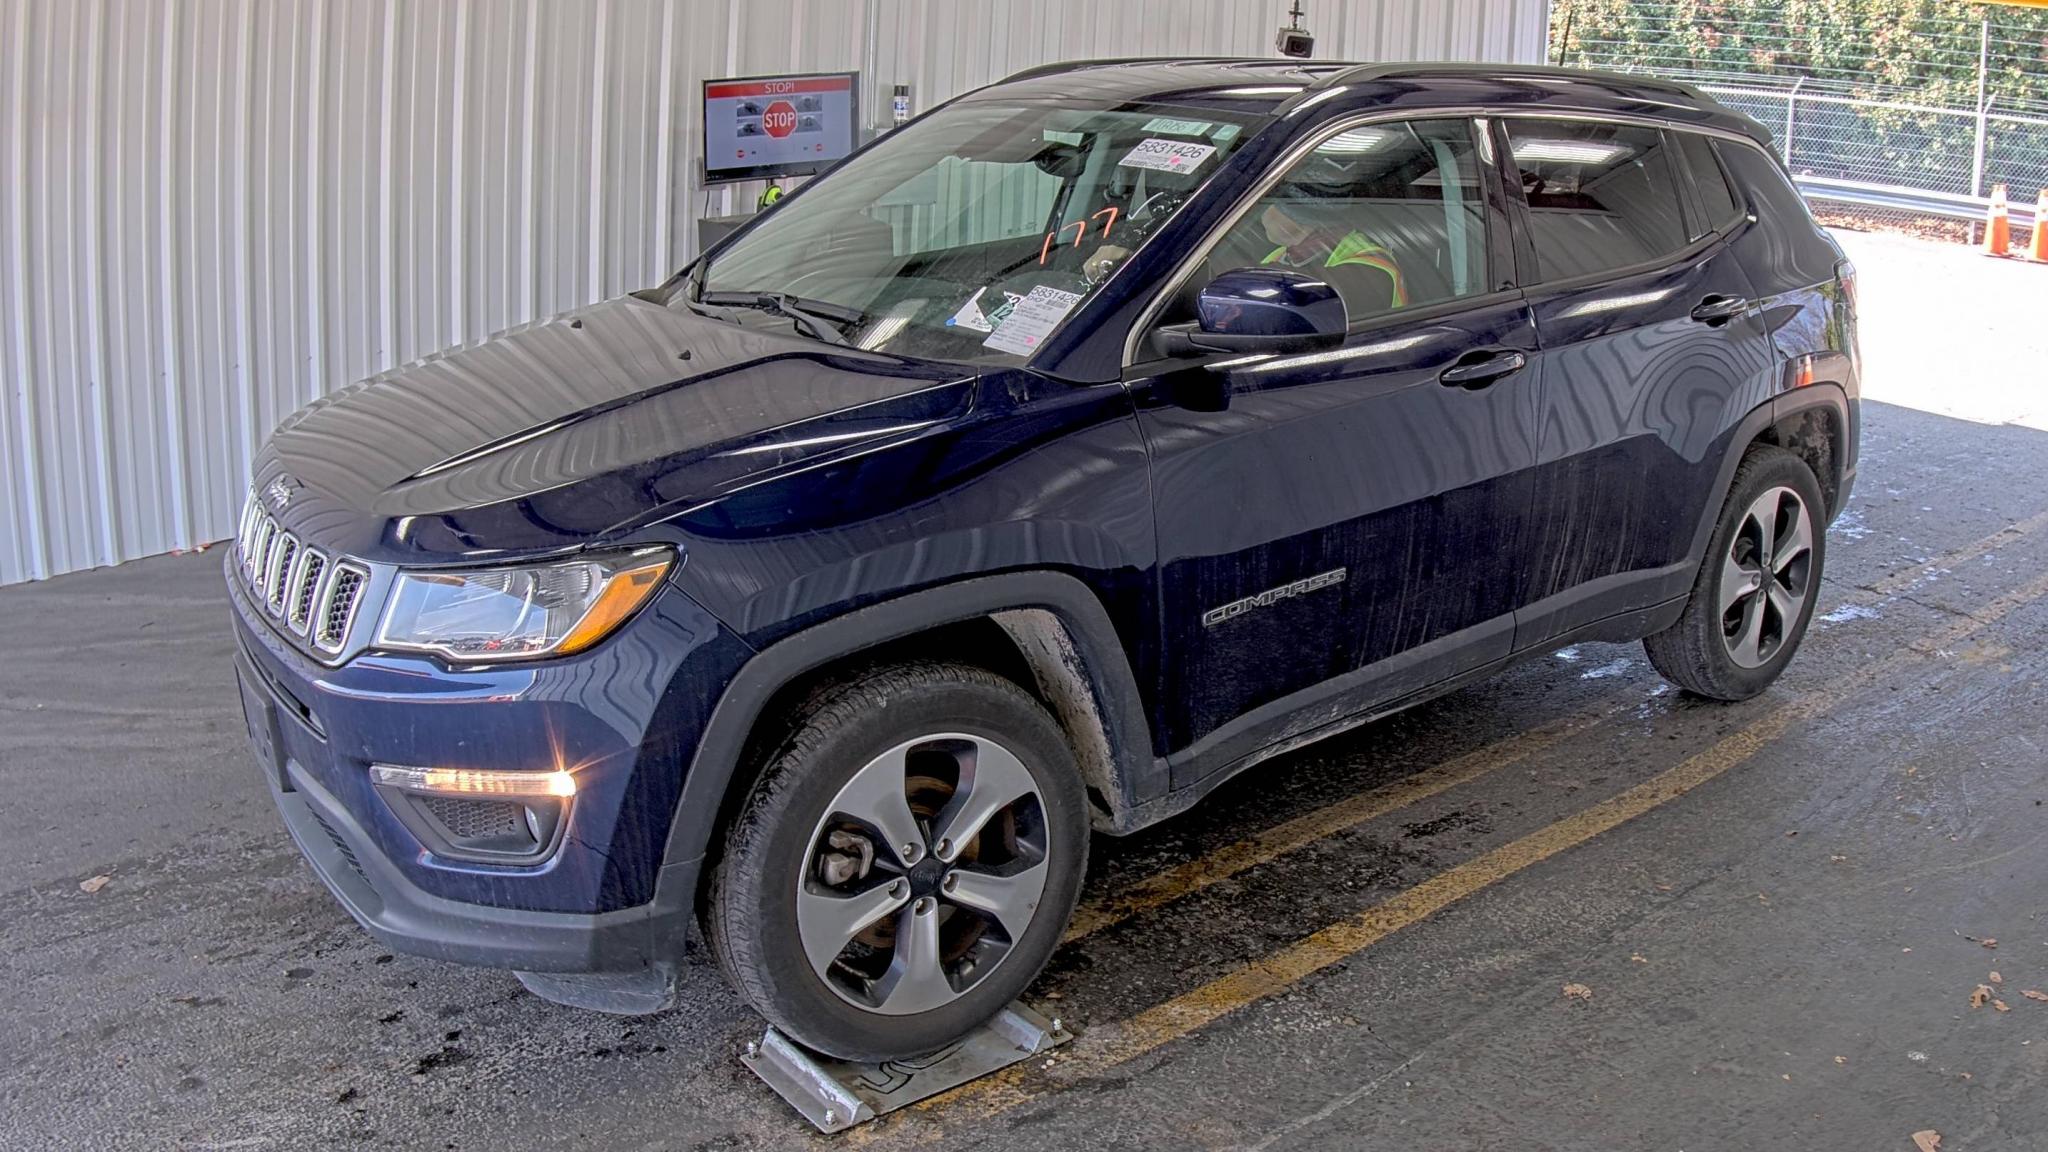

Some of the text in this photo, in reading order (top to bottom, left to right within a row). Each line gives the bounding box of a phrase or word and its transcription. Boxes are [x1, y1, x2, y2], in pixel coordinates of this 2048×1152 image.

[764, 82, 795, 94] STOP!
[764, 112, 795, 129] STOP
[1137, 140, 1205, 159] 5831426
[1031, 286, 1081, 305] 5831426
[1202, 567, 1347, 627] COMPASS
